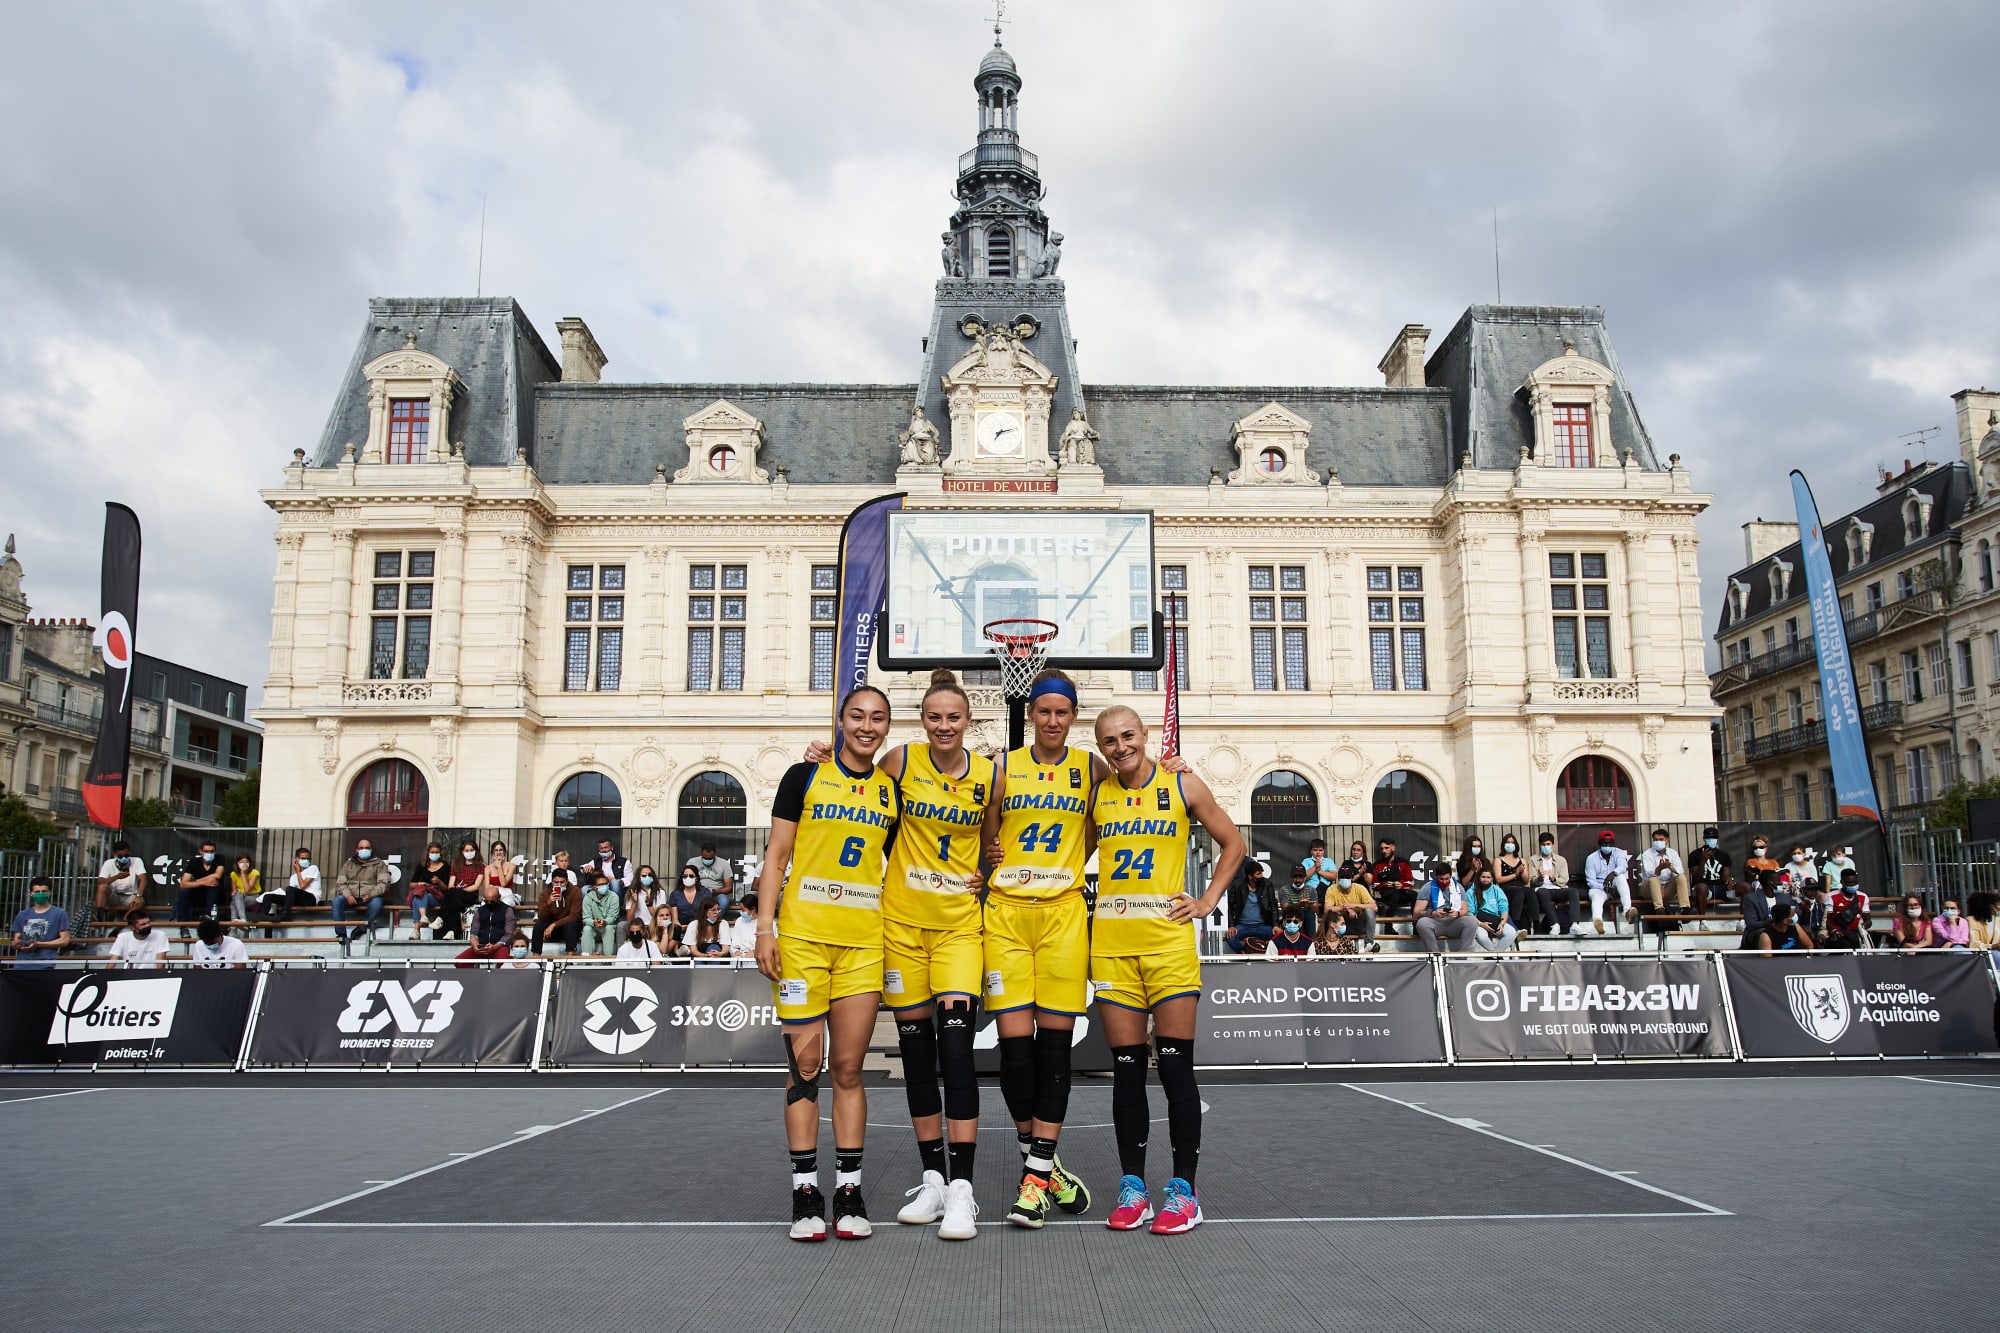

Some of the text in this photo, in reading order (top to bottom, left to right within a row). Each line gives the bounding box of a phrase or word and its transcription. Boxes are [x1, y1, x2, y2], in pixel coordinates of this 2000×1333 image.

[993, 481, 1010, 492] DE
[1014, 481, 1051, 492] VILLE
[945, 534, 1095, 556] POITIERS
[1003, 791, 1086, 815] ROMÂNIA
[937, 834, 952, 861] 1
[1018, 822, 1063, 853] 44
[838, 835, 866, 868] 6
[1111, 848, 1155, 880] 24
[909, 872, 928, 882] BANCA
[803, 883, 826, 893] BANCA
[1210, 987, 1387, 1004] GRAND POITIERS
[1876, 981, 1906, 990] RÉGION
[1519, 984, 1700, 1012] FIBA3x3W
[1852, 989, 1936, 1005] Nouvelle-
[57, 973, 162, 1047] Poitiers
[670, 1005, 714, 1026] 3X3
[1859, 1006, 1941, 1027] Aquitaine
[1213, 1026, 1391, 1039] communauté urbaine
[1522, 1022, 1709, 1036] WE GOT OUR OWN PLAYGROUND
[339, 1038, 435, 1049] WOMEN'S SERIES
